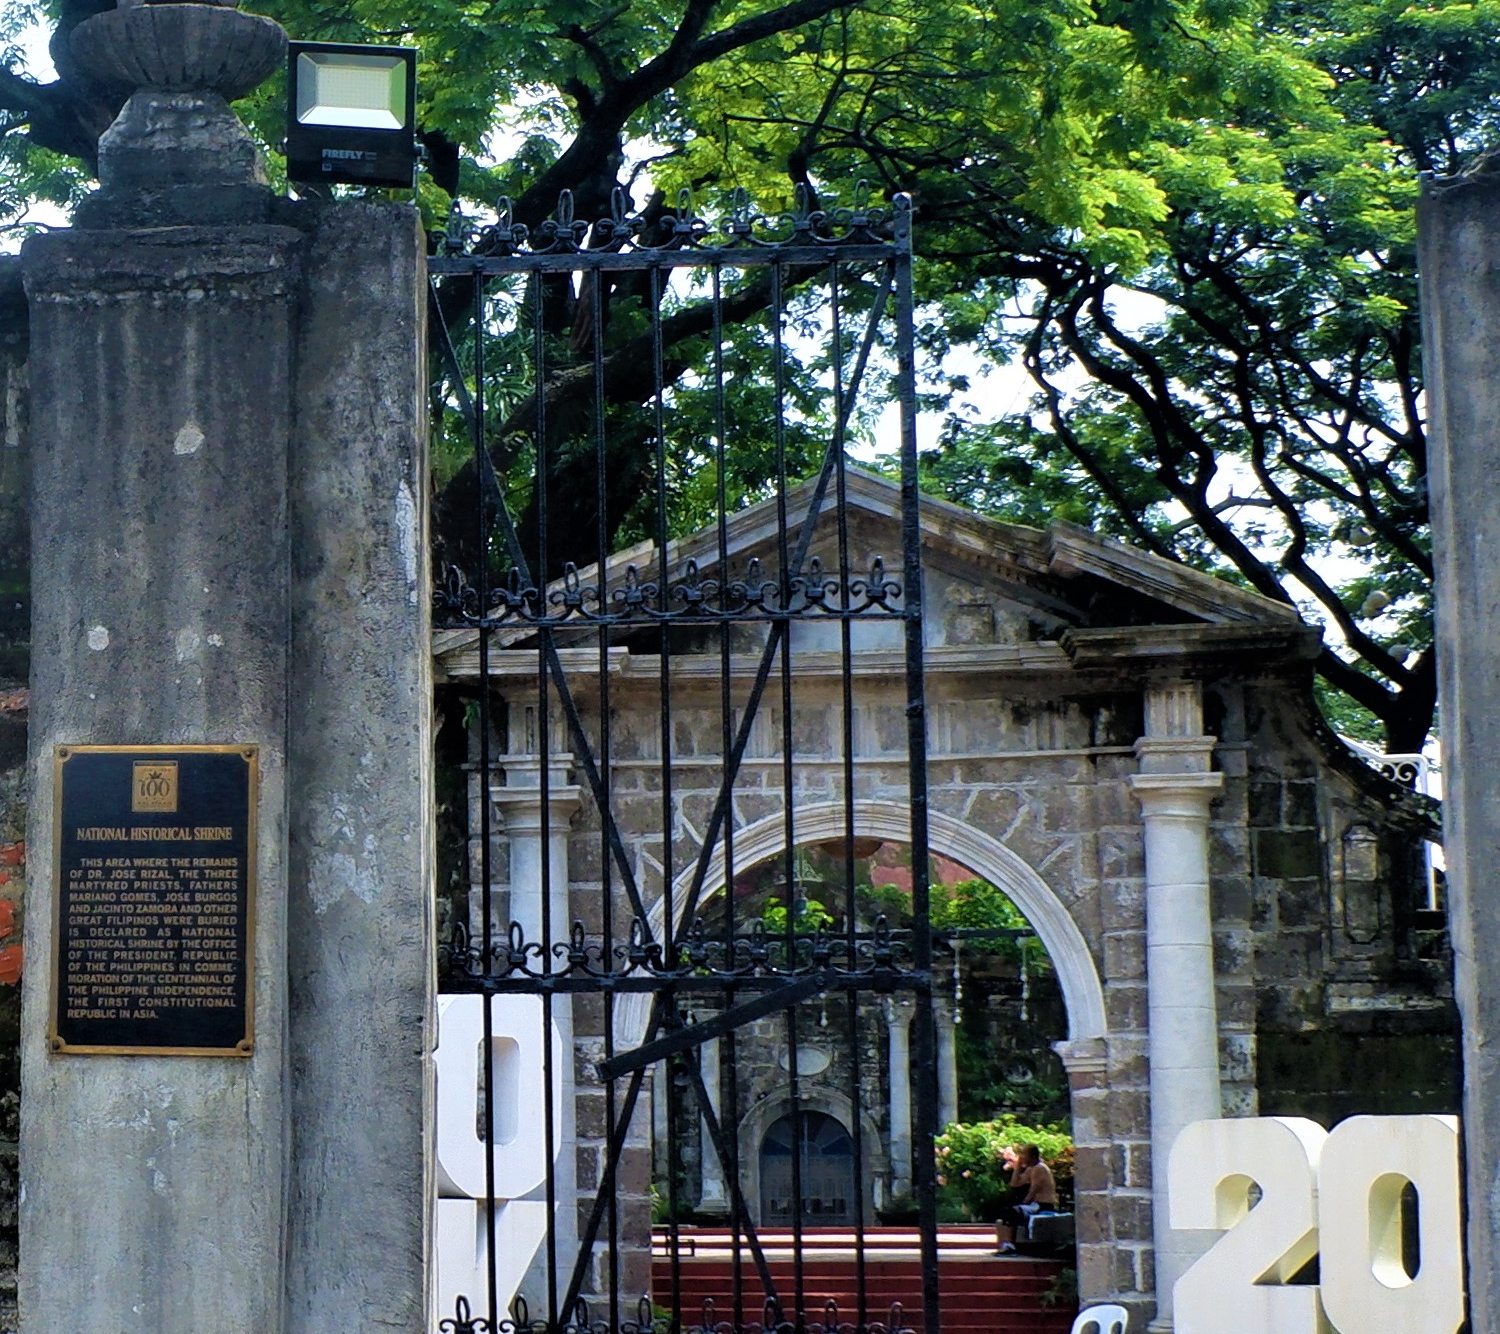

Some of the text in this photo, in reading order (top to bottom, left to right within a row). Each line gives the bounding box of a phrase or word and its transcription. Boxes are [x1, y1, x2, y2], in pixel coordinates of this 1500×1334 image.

[322, 149, 363, 160] FIREFLY
[77, 827, 232, 840] NATIONAL HISTORICAL SHRINE
[80, 858, 238, 867] THIS AREA WHERE THE REMAINS
[70, 870, 83, 878] OF
[110, 870, 136, 878] JOSE
[179, 870, 199, 878] THE
[204, 870, 238, 878] THREE
[70, 881, 128, 890] MARTYRED
[190, 881, 237, 890] FATHERS
[70, 893, 116, 901] MARIANO
[164, 893, 190, 901] JOSE
[195, 893, 237, 901] BURGOS
[69, 905, 237, 913] AND JACINTO ZAMORA AND OTHER
[69, 916, 237, 924] GREAT FILIPINOS WERE BURIED
[69, 928, 237, 936] IS DECLARED AS NATIONAL
[69, 939, 237, 948] HISTORICAL SHRINE BY THE OFFICE
[68, 951, 82, 960] OF
[88, 951, 107, 960] THE
[183, 951, 237, 960] REPUBLIC
[68, 963, 81, 971] OF
[86, 963, 105, 971] THE
[110, 963, 174, 971] PHILIPPINES
[179, 963, 190, 971] IN
[68, 975, 236, 983] MORATION OF THE CENTENNIAL OF
[68, 986, 87, 995] THE
[92, 986, 149, 995] PHILIPPINE
[68, 998, 236, 1007] THE FIRST CONSTITUTIONAL
[68, 1010, 116, 1018] REPUBLIC
[120, 1010, 130, 1018] IN
